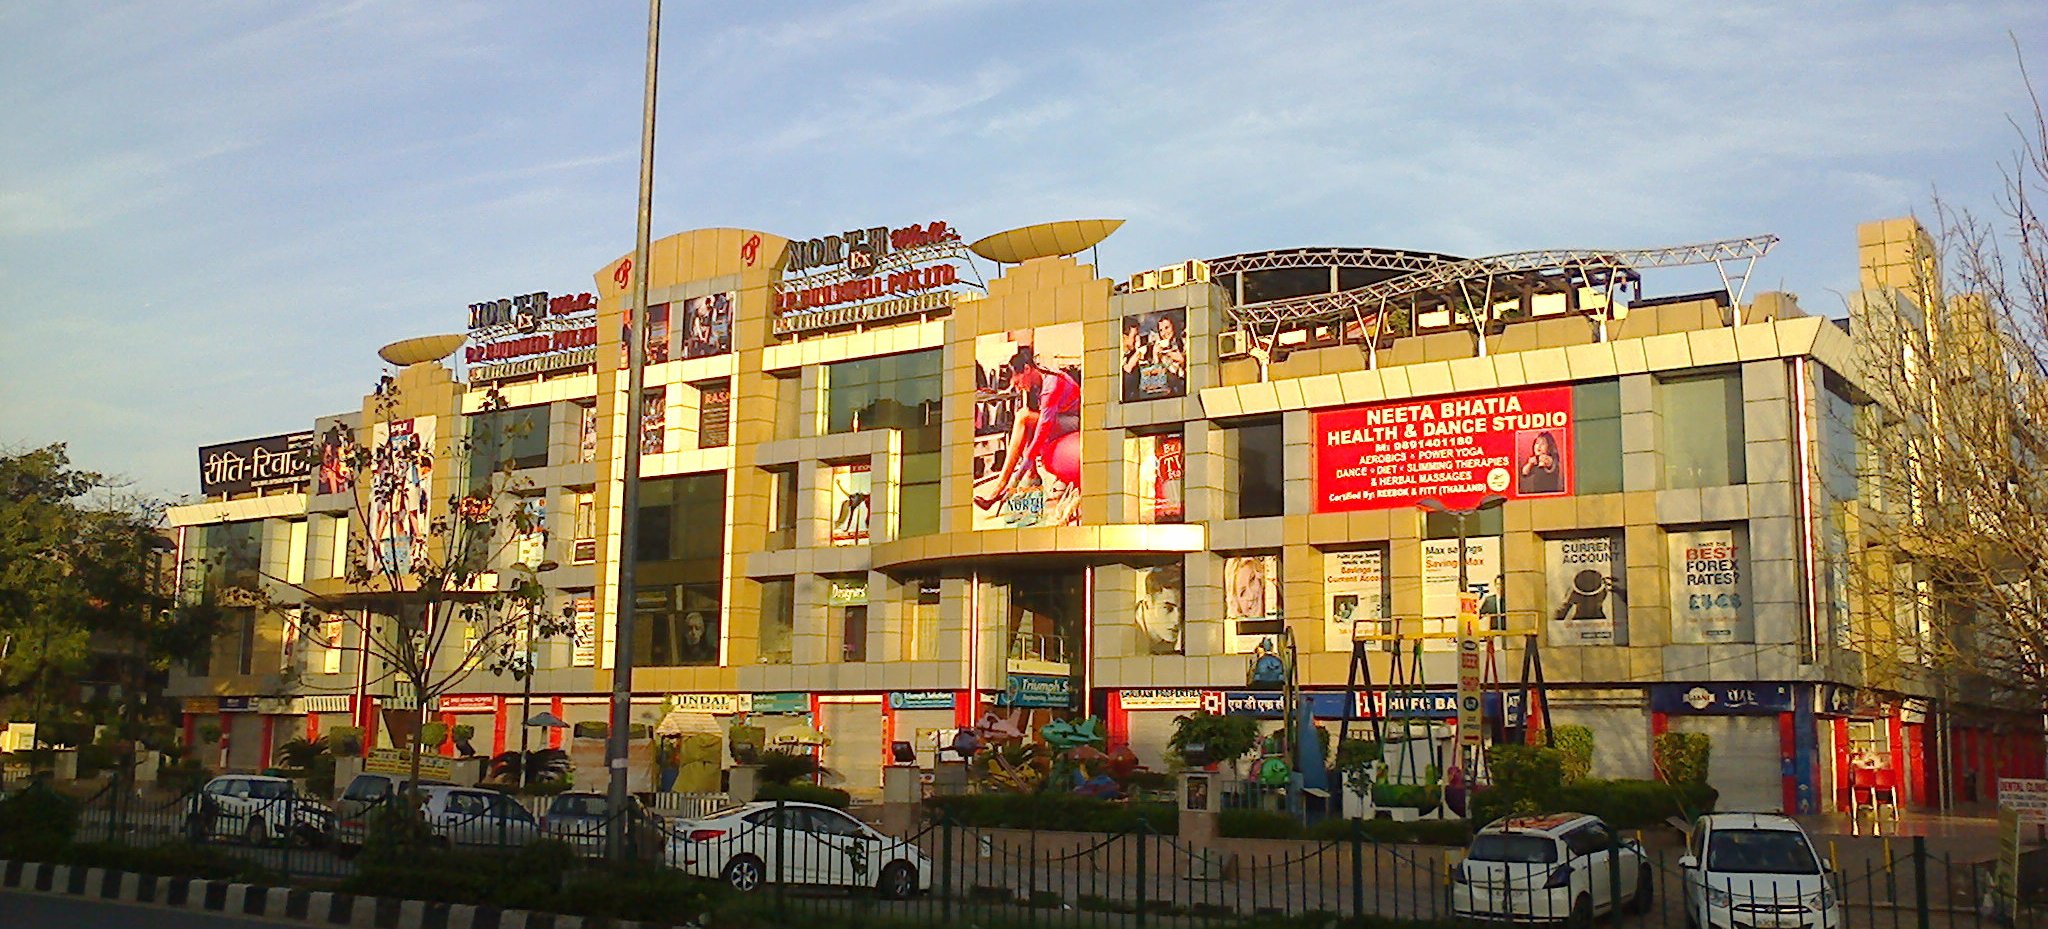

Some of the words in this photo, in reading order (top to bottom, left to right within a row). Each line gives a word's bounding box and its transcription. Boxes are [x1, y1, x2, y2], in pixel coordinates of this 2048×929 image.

[787, 226, 889, 272] NORTH
[1367, 406, 1435, 426] NEETA
[1441, 396, 1522, 419] BHATIA
[1327, 427, 1398, 446] HEALTH
[1403, 423, 1418, 439] &
[1423, 418, 1486, 437] DANCE
[1492, 412, 1568, 431] STUDIO
[1359, 453, 1407, 465] AEROBICS
[1418, 449, 1454, 461] POWER
[1456, 447, 1484, 458] YOGA
[1336, 467, 1368, 479] DANCE
[1377, 464, 1398, 476] DIET
[1406, 461, 1453, 473] SLIMMING
[1456, 456, 1509, 469] THERAPIES
[1370, 477, 1378, 487] &
[1379, 474, 1418, 487] HERBAL
[1419, 471, 1472, 483] MASSAGES
[1377, 487, 1409, 499] REEBOK
[1426, 546, 1445, 555] Max
[1447, 546, 1483, 555] sangs
[1562, 540, 1618, 554] CURRENT
[1686, 546, 1740, 560] BEST
[1562, 552, 1619, 565] ACCOUNT
[1686, 559, 1739, 573] FOREX
[1686, 572, 1740, 586] RATES?
[1022, 679, 1061, 694] Triumph
[678, 696, 730, 706] JINDAL
